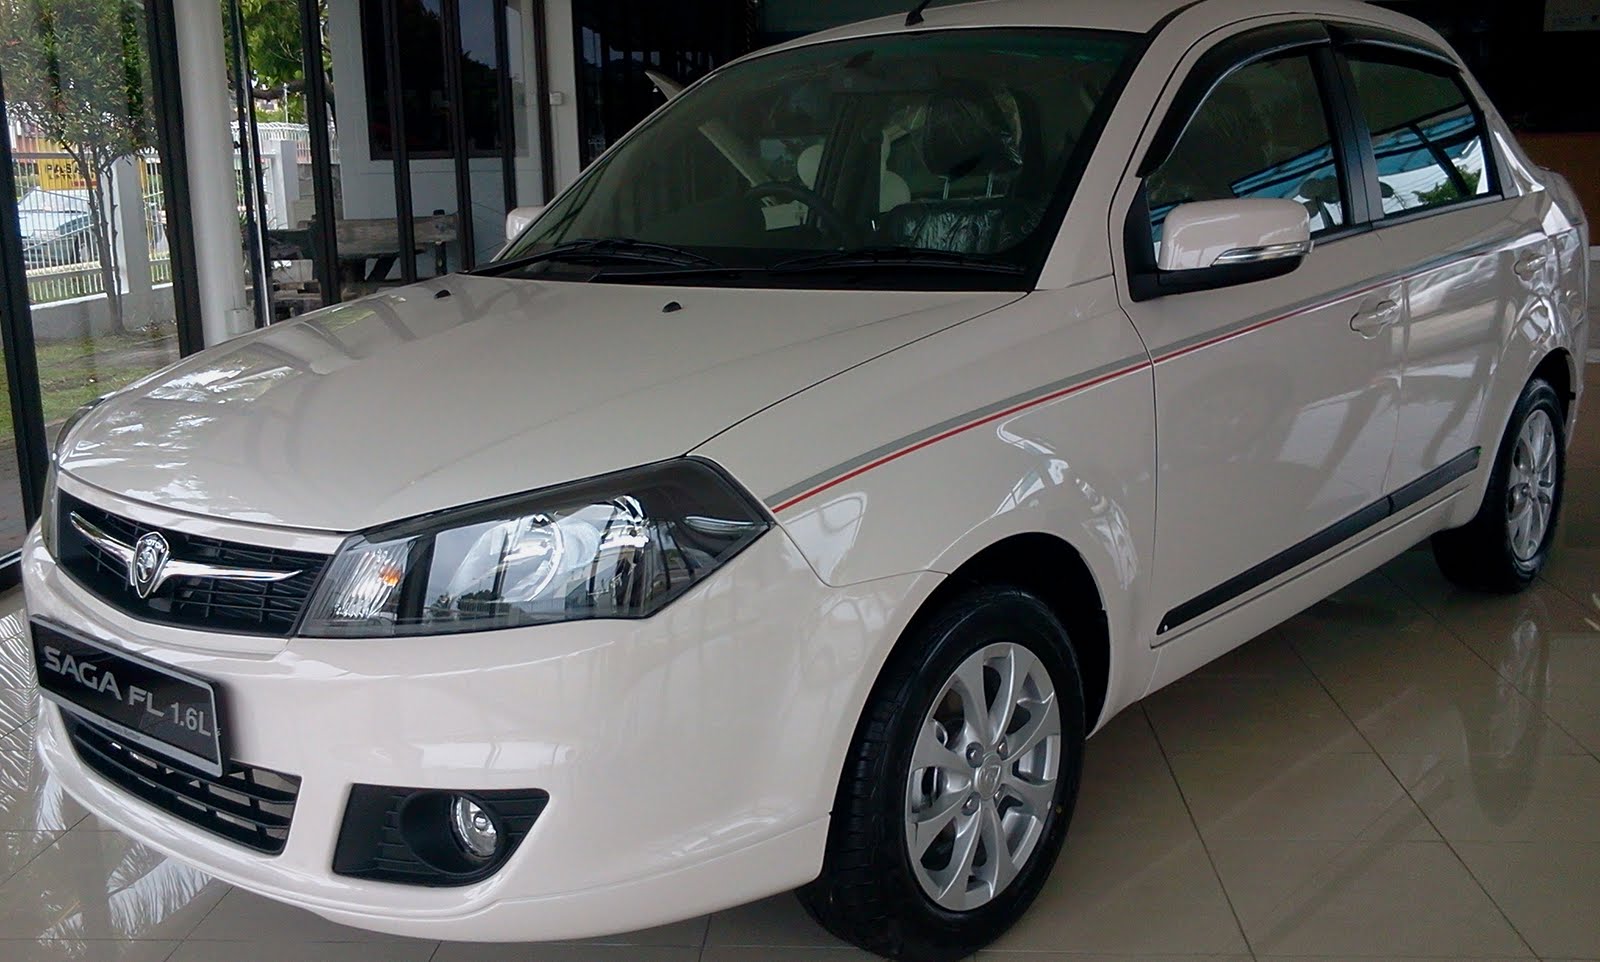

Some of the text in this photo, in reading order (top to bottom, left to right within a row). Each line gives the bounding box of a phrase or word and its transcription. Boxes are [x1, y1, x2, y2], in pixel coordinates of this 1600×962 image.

[43, 645, 122, 701] SAGA
[129, 685, 165, 718] FL
[170, 702, 211, 737] 1.6L
